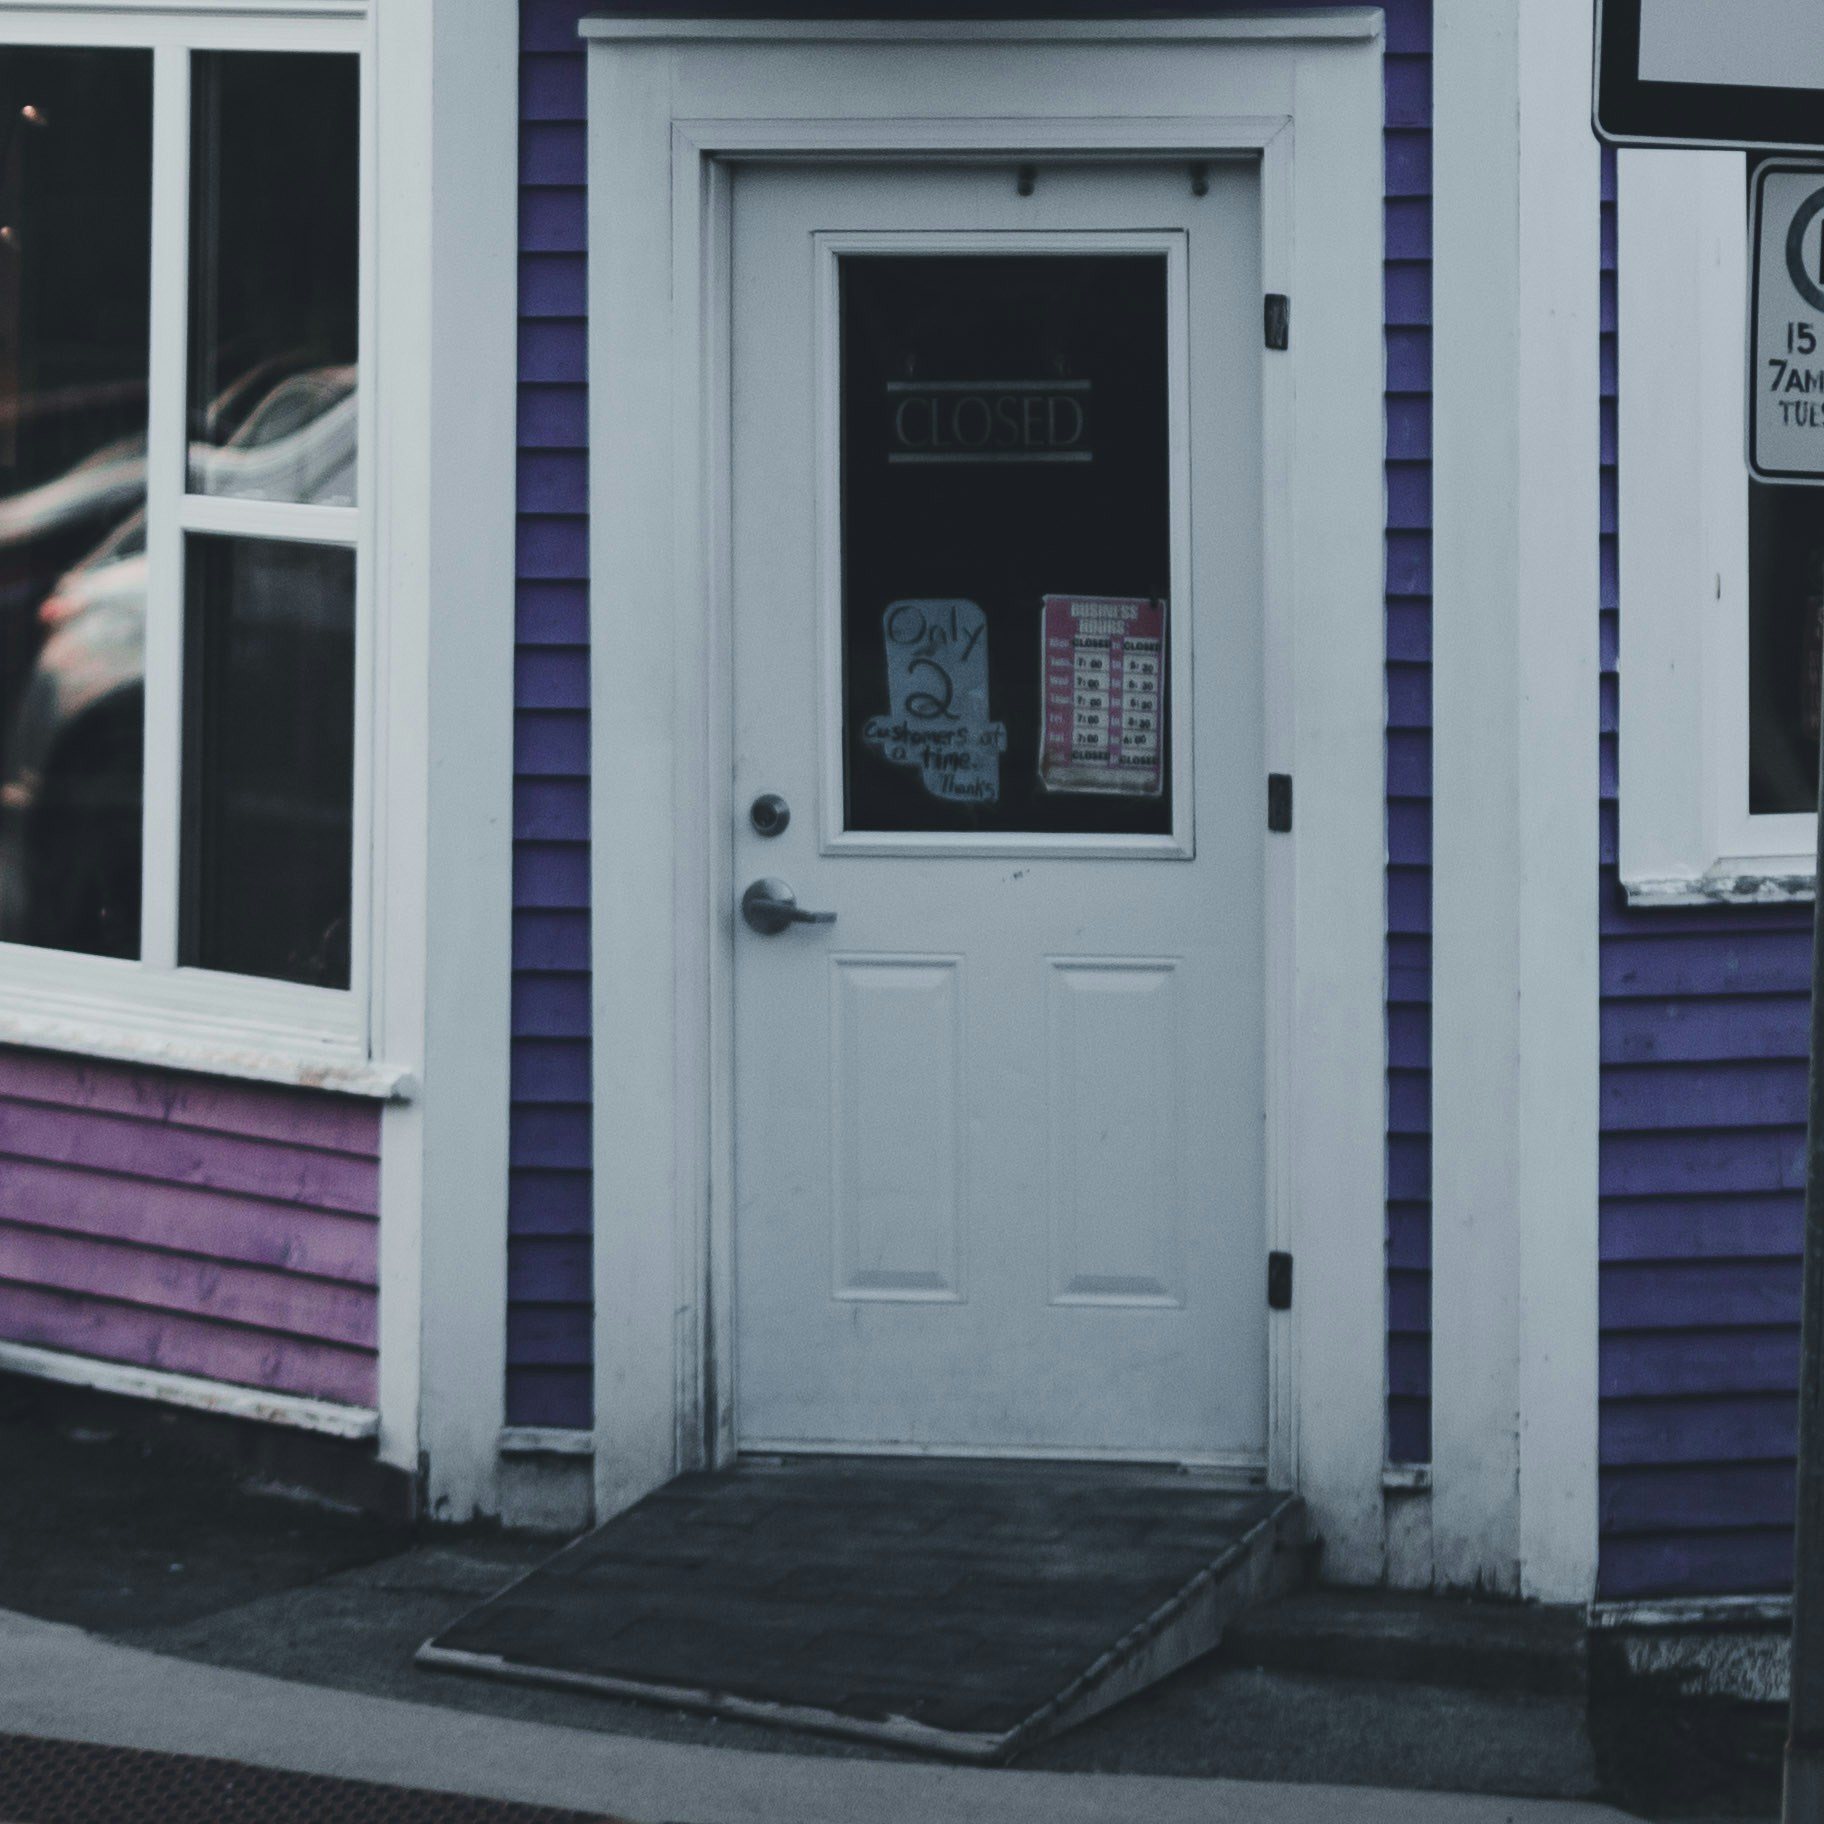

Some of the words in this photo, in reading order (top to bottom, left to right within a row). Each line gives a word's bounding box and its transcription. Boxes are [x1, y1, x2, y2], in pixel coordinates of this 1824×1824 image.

[1787, 321, 1817, 355] 15
[895, 394, 1084, 448] CLOSED
[888, 604, 986, 662] Only
[905, 657, 961, 721] 2
[892, 746, 906, 761] a
